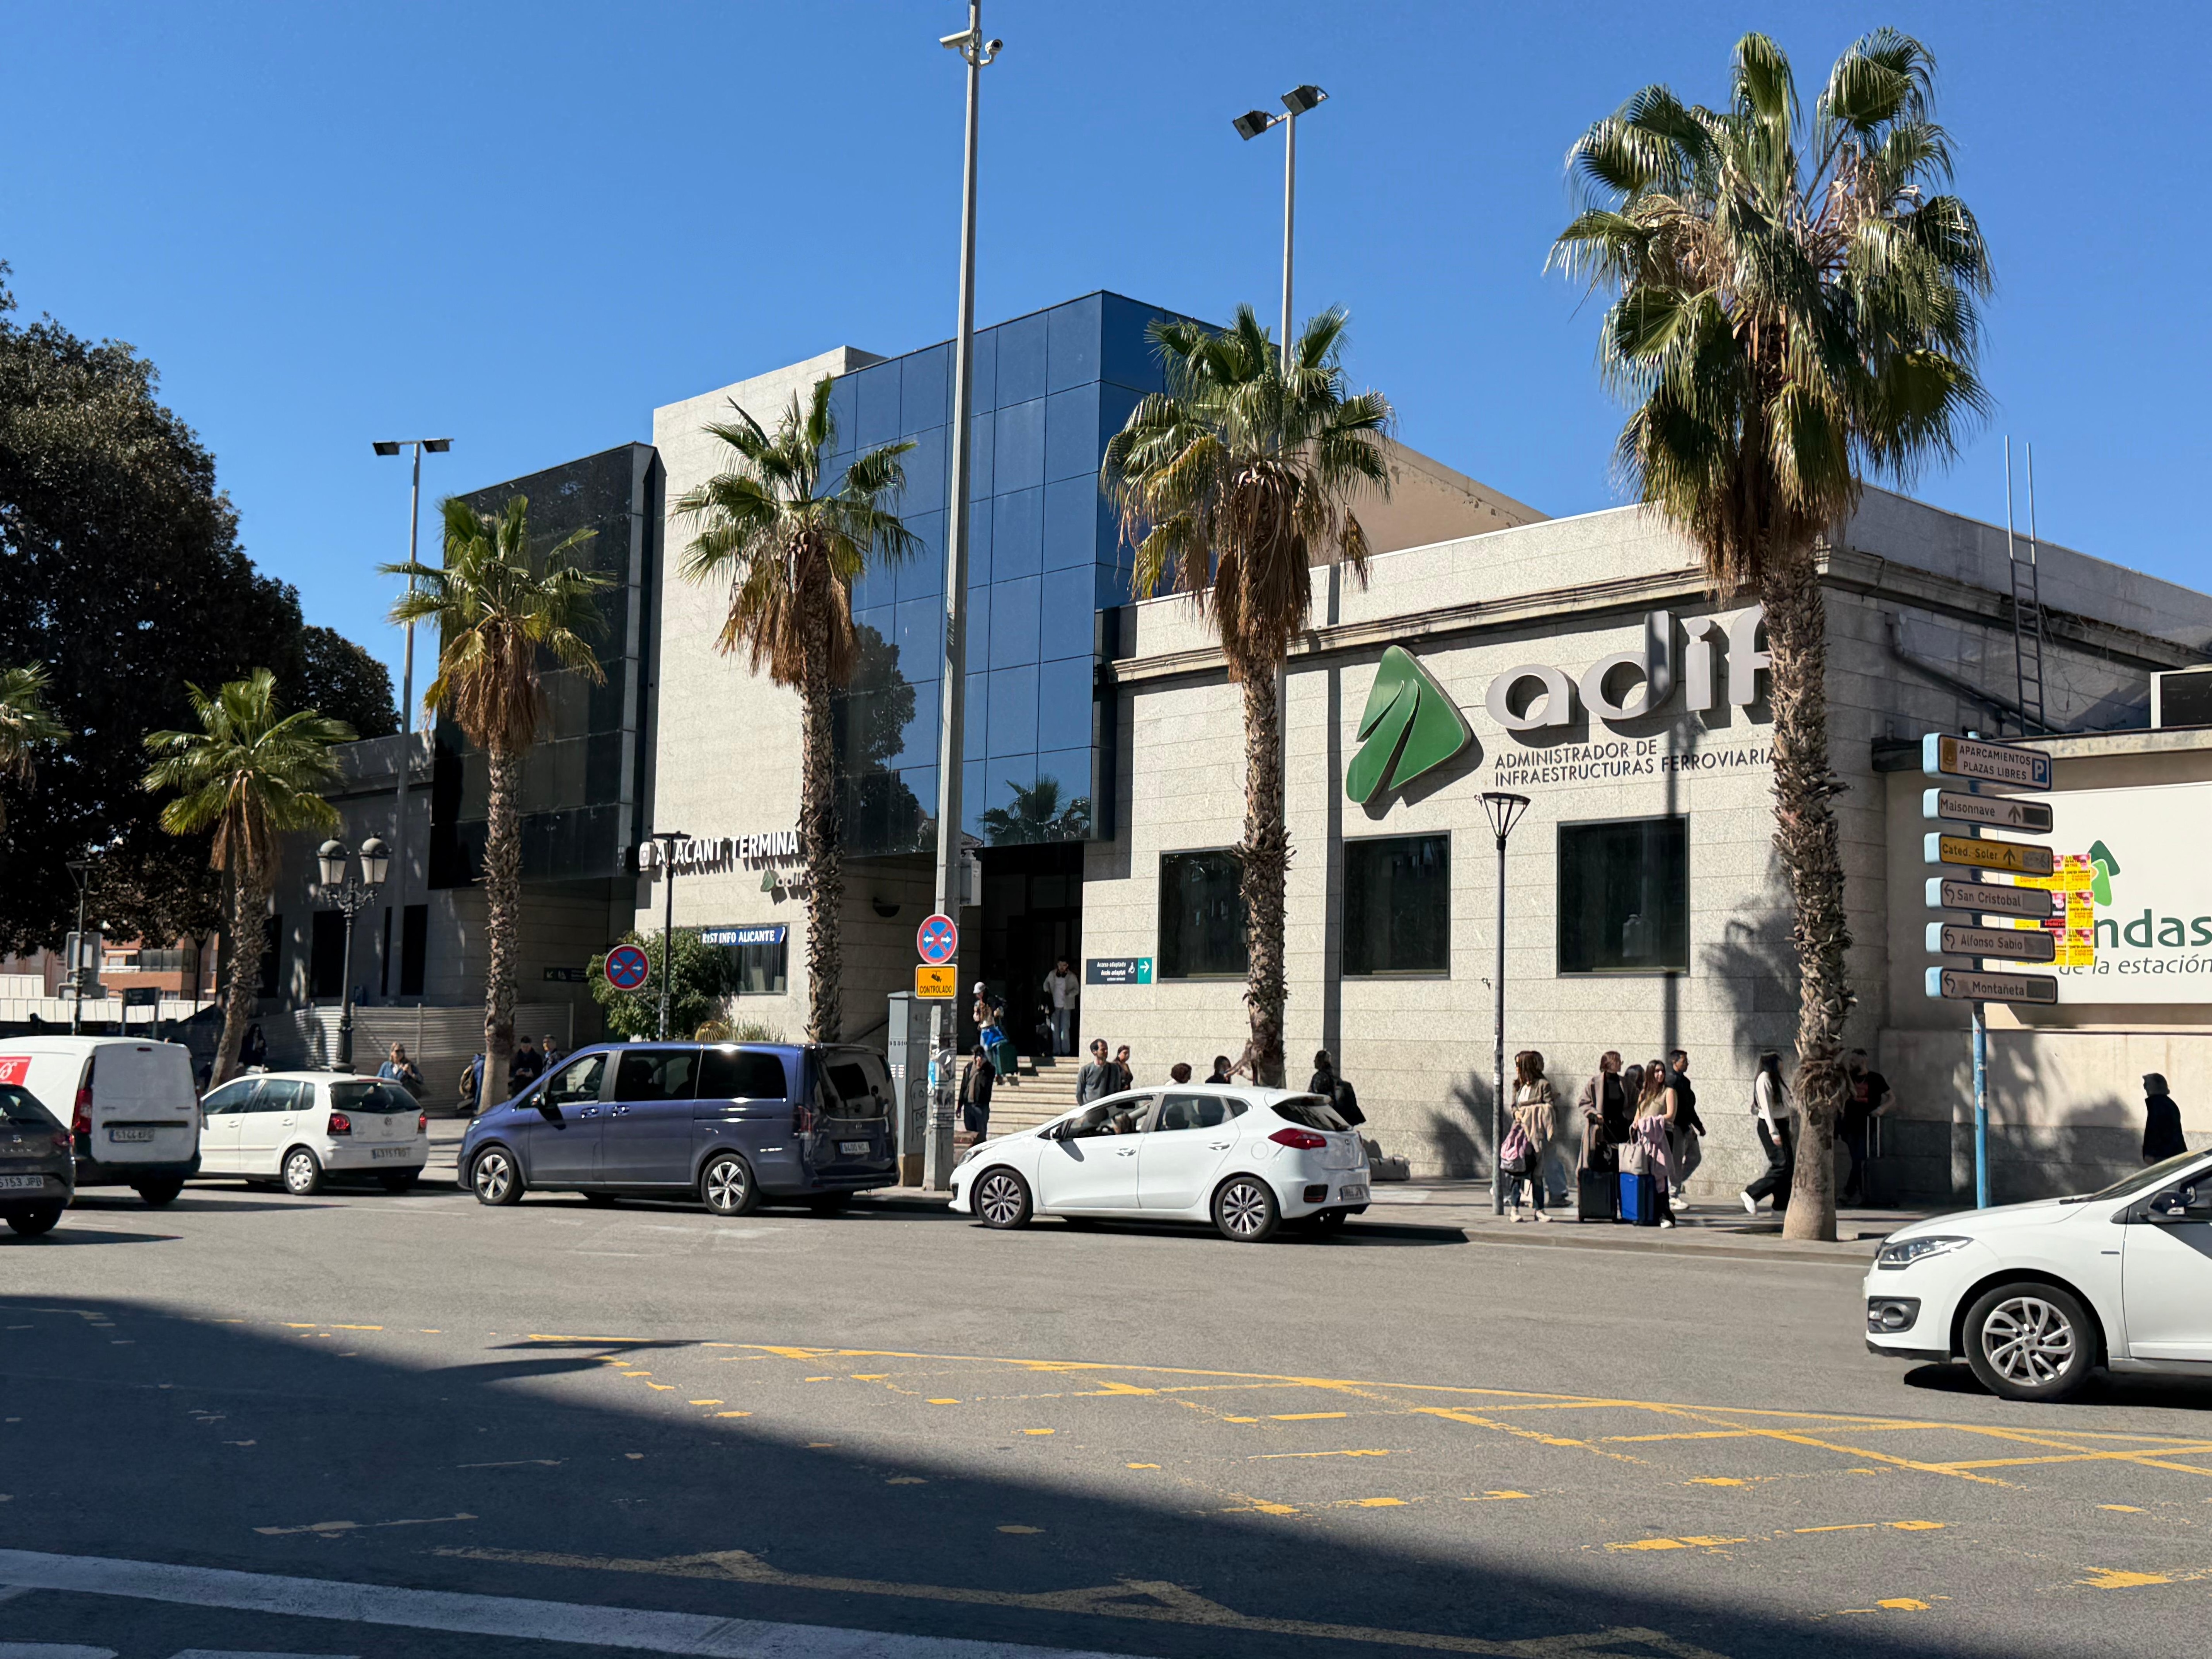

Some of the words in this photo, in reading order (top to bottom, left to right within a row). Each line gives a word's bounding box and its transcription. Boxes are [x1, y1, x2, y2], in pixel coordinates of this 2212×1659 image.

[1485, 604, 1772, 730] adif
[1494, 742, 1630, 769] ADMINISTRADOR
[1636, 739, 1657, 755] DE
[1959, 745, 2031, 766] APARCAMIENTOS
[1495, 757, 1654, 787] INFRAESTRUCTURAS
[1963, 761, 1994, 775] PLAZAS
[1997, 767, 2027, 780] LIBRES
[1940, 799, 1995, 816] Maisonnave
[656, 835, 724, 865] AACANT
[1942, 844, 1971, 857] Cated.
[1975, 848, 1998, 860] Soler
[1957, 889, 1974, 902] San
[1978, 892, 2021, 906] Cristobal
[719, 932, 737, 944] INFO
[738, 930, 775, 943] ALICANTE
[1961, 934, 1994, 948] Alfonso
[1998, 937, 2023, 950] Sabio
[2092, 955, 2110, 975] la
[2118, 953, 2212, 975] estación
[920, 985, 952, 994] CONTROLADO
[1972, 981, 2024, 996] Montañeta
